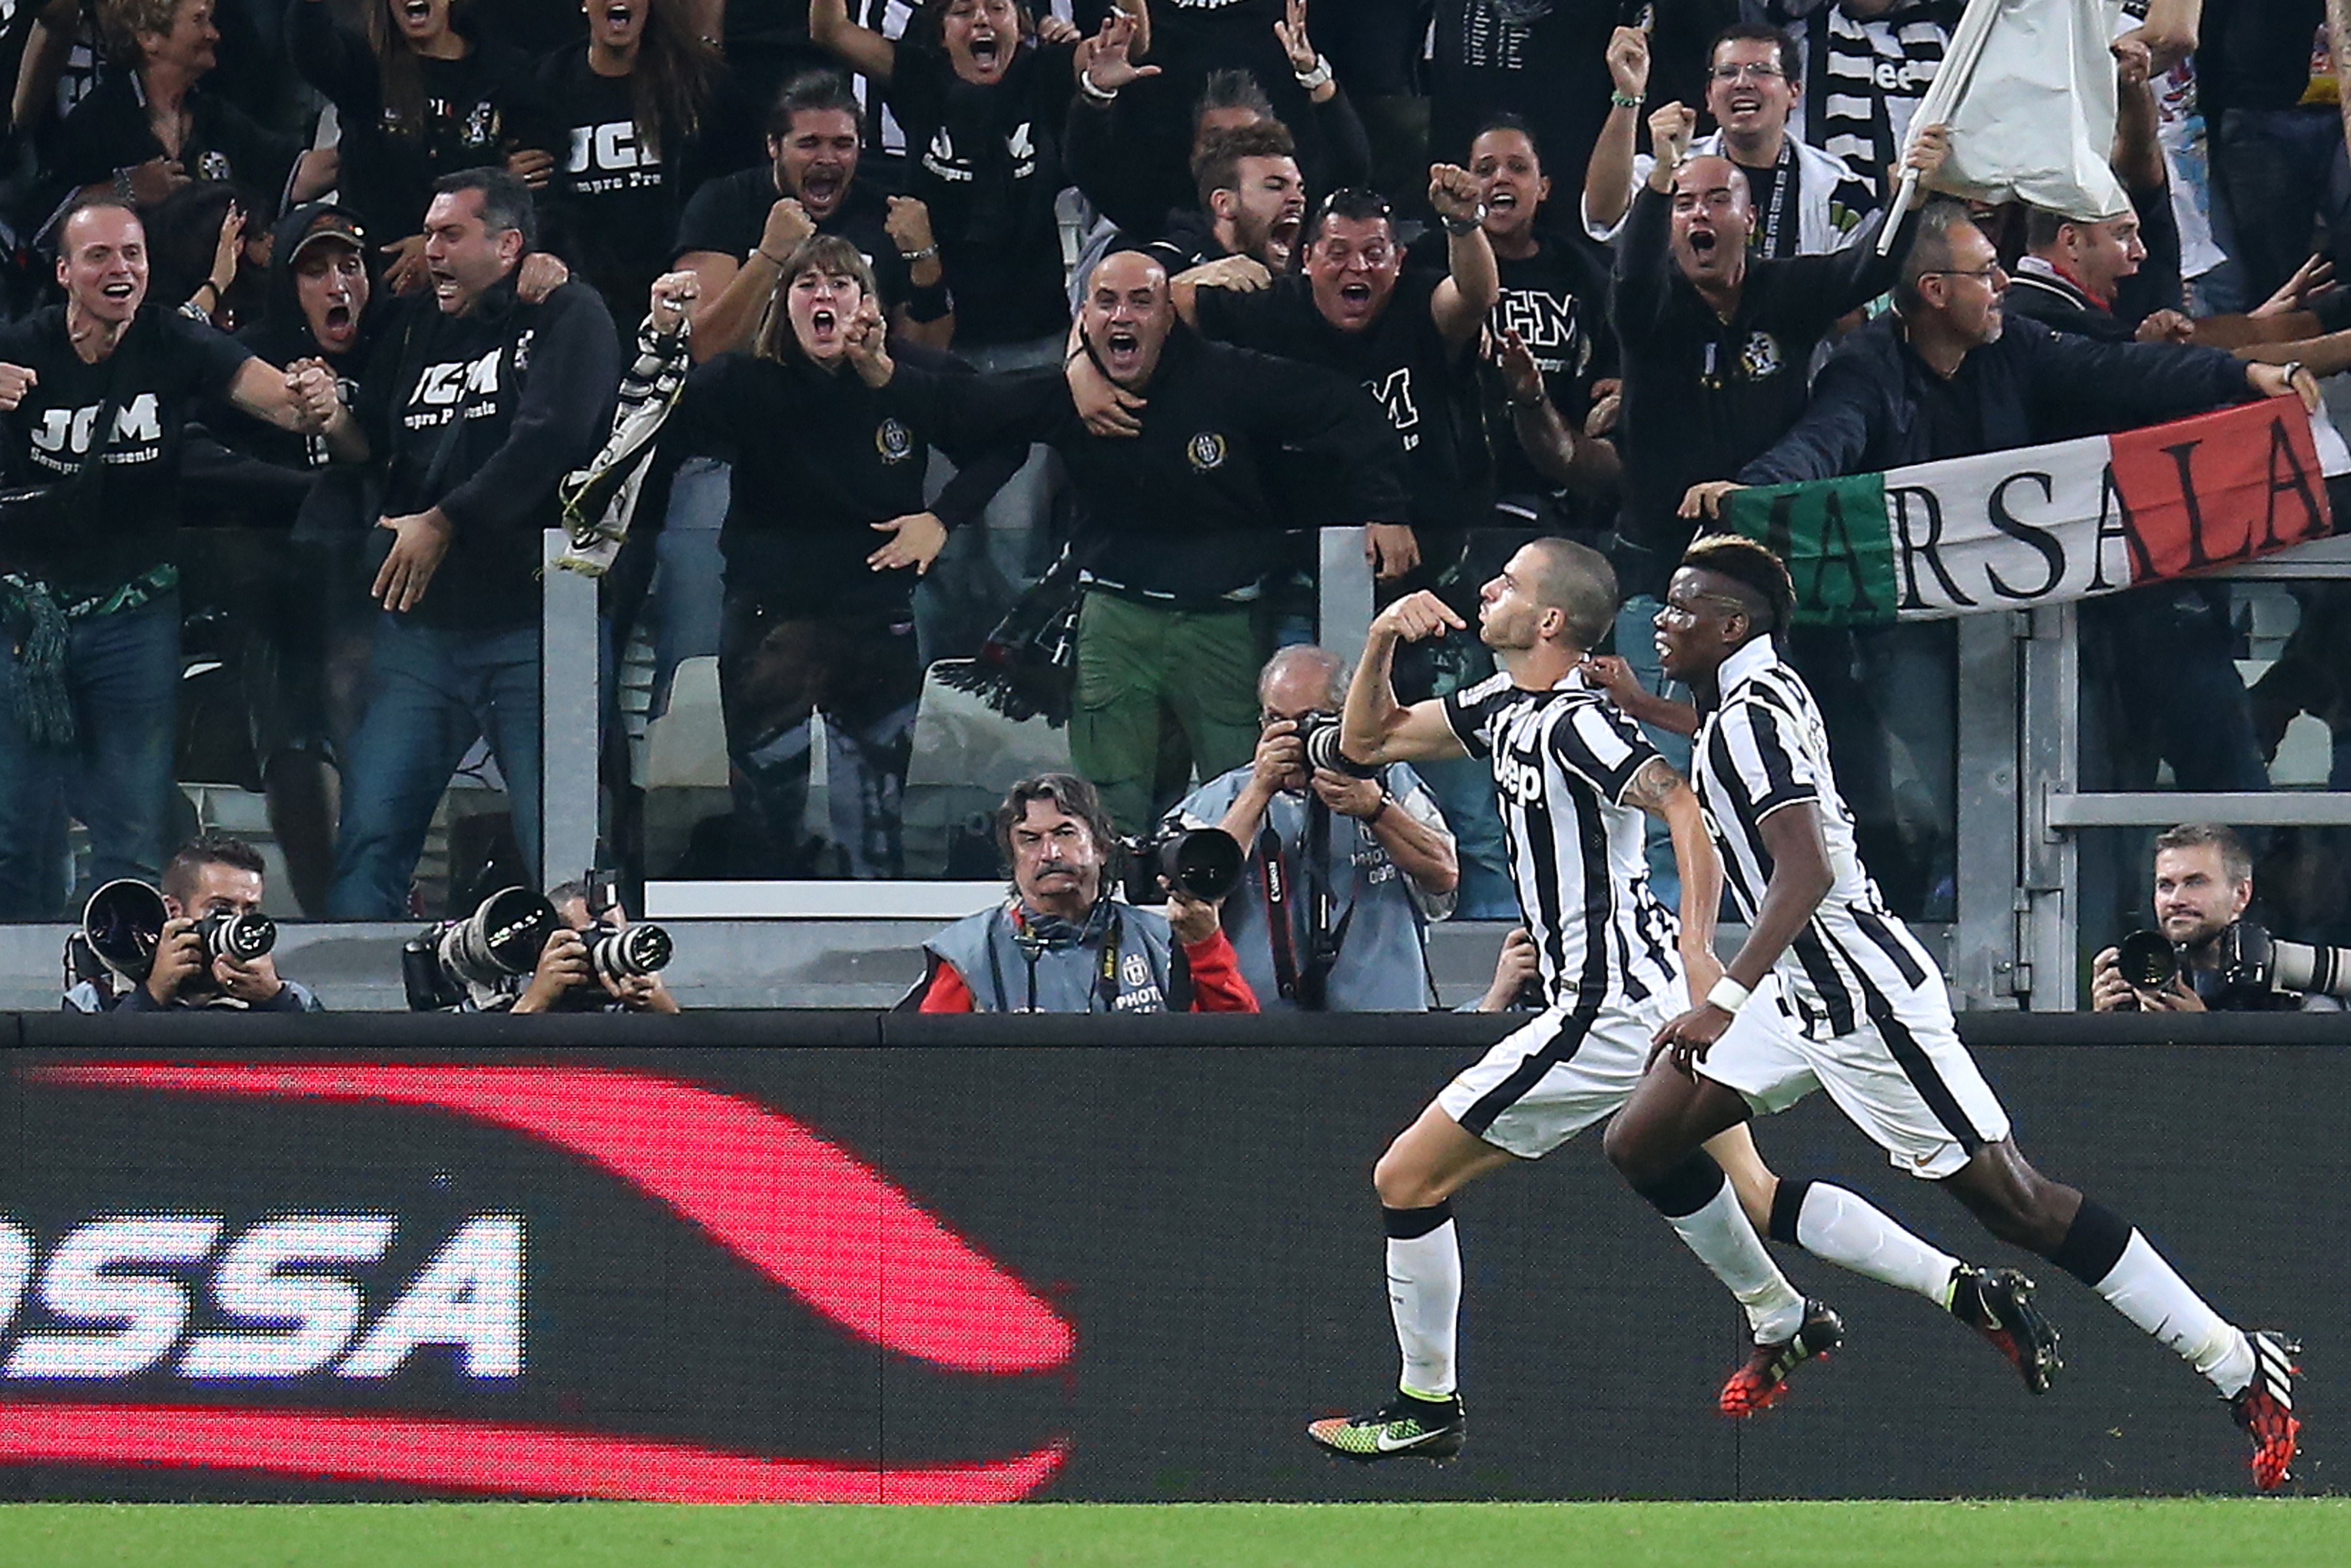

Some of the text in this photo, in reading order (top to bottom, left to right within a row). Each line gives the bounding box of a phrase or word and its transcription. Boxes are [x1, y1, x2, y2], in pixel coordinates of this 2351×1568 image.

[30, 447, 159, 475] Sempr resente
[1268, 861, 1282, 903] Canon
[1115, 985, 1164, 1010] PHOT
